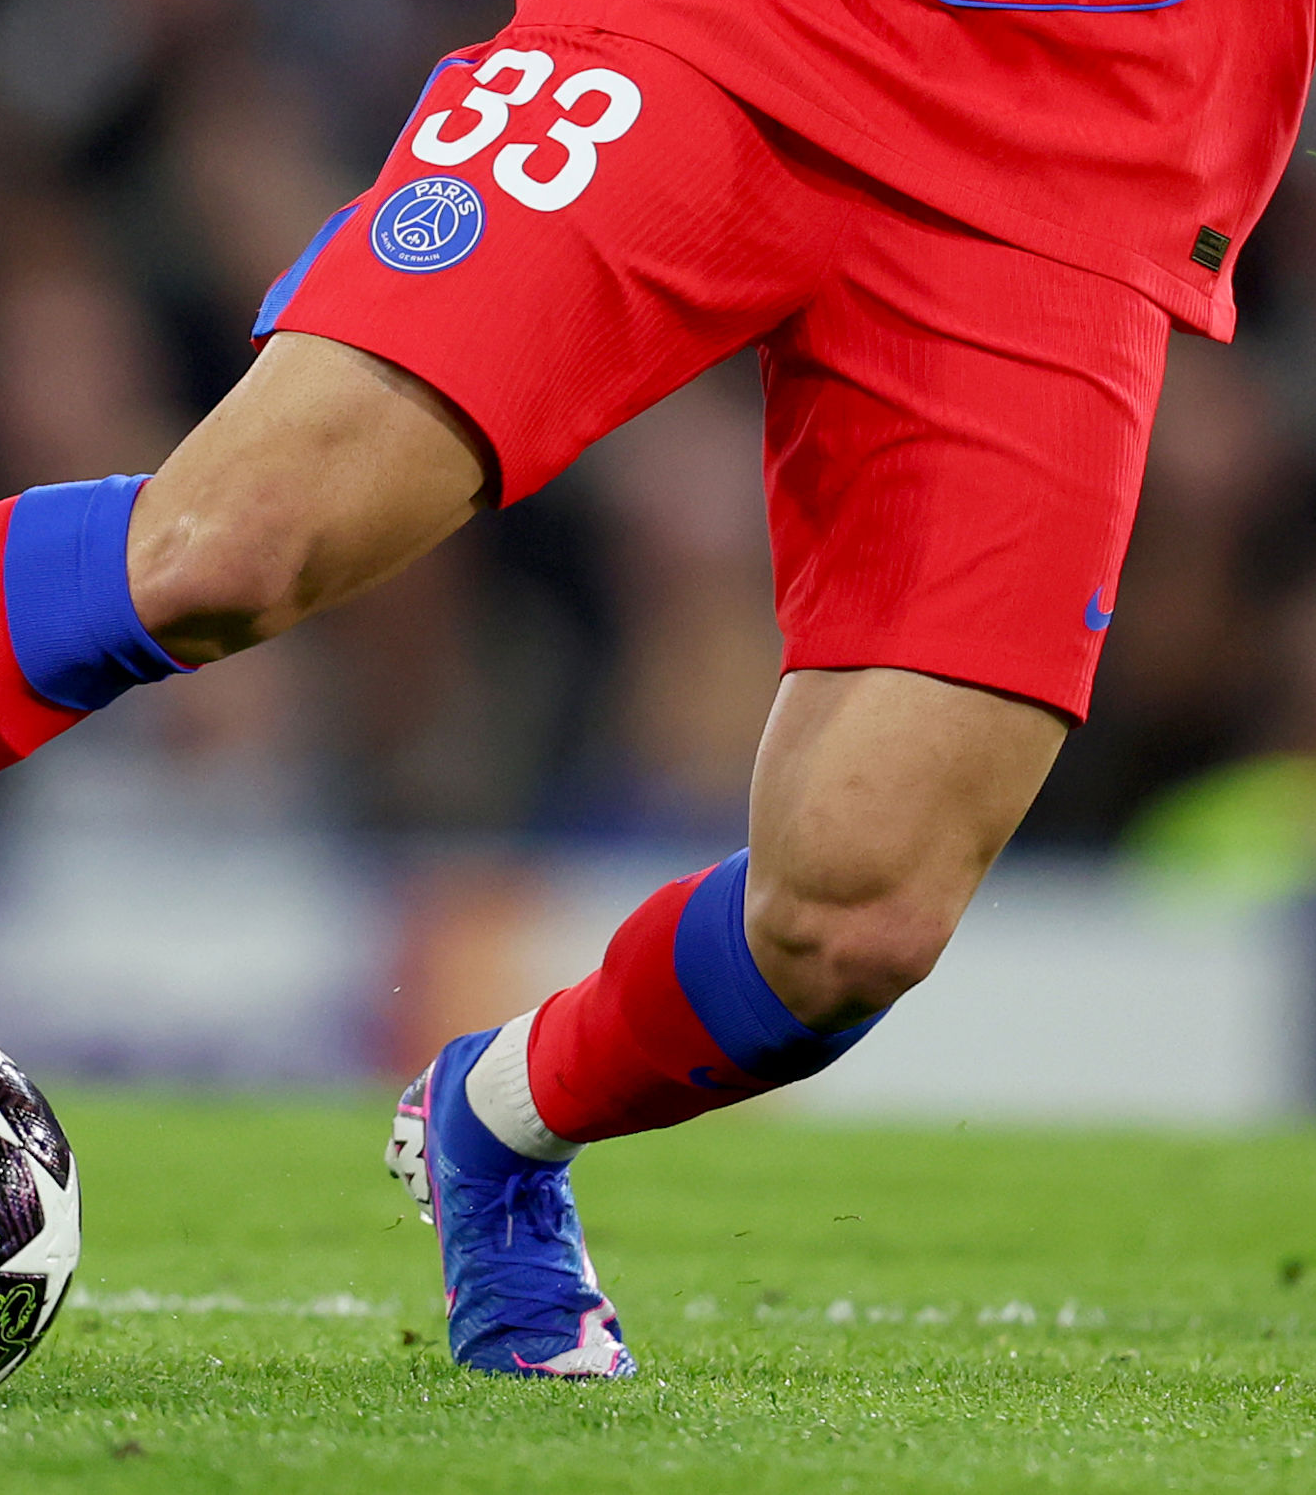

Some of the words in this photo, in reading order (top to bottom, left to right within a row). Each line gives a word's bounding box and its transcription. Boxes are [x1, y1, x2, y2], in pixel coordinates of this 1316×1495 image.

[411, 48, 643, 212] 33
[414, 182, 475, 216] PARIS
[398, 252, 441, 262] GERMAIN
